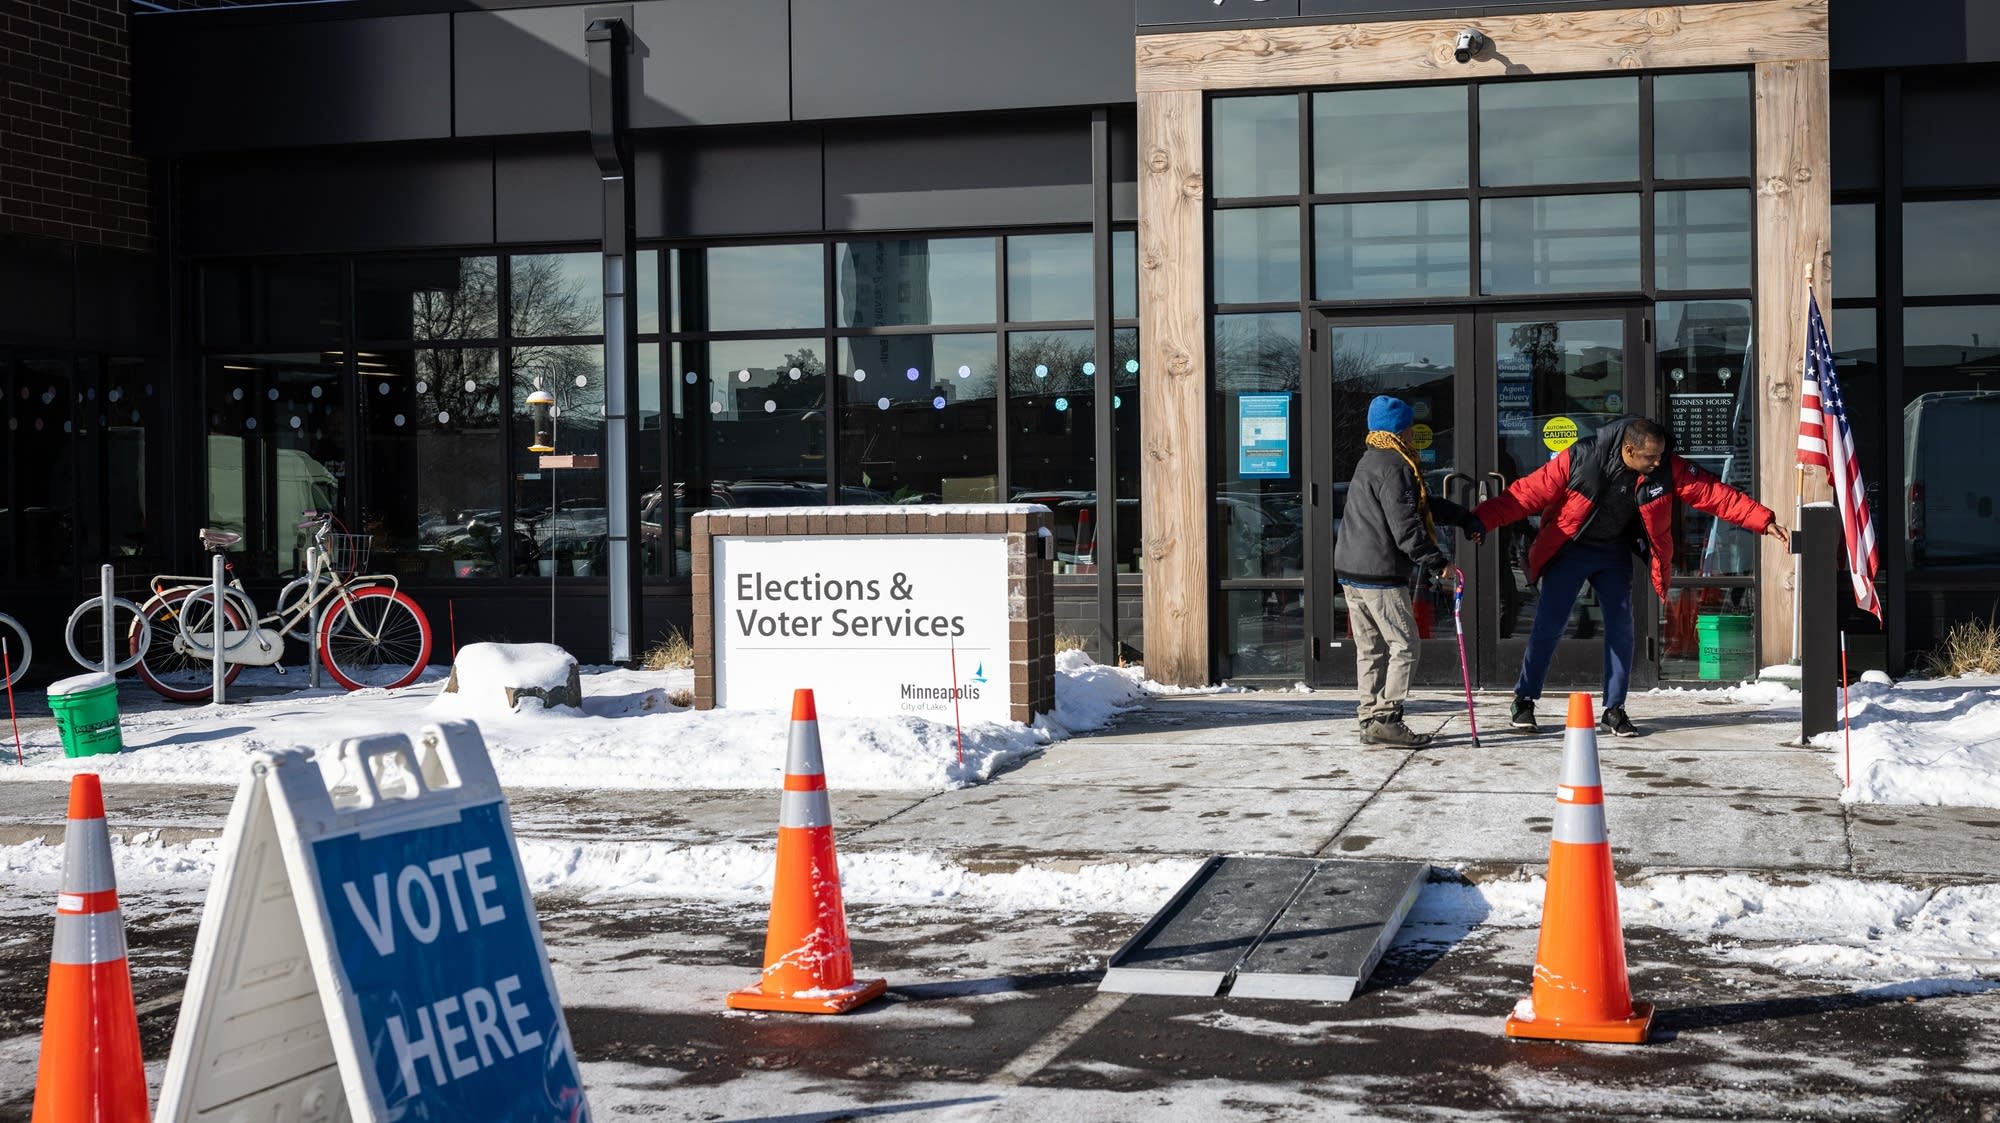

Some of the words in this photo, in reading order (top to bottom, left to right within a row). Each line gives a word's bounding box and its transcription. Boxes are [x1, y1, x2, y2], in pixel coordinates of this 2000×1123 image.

[1503, 385, 1526, 393] Agent
[1502, 420, 1527, 429] Voting
[1544, 430, 1577, 438] CAUTION
[737, 571, 881, 601] Elections
[889, 571, 914, 601] &
[735, 608, 823, 637] Voter
[831, 608, 965, 637] Services
[901, 683, 980, 703] Minneapolis
[900, 702, 916, 712] City
[916, 702, 925, 711] of
[926, 702, 947, 711] Lakes
[342, 847, 506, 957] VOTE
[386, 975, 543, 1098] HERE
